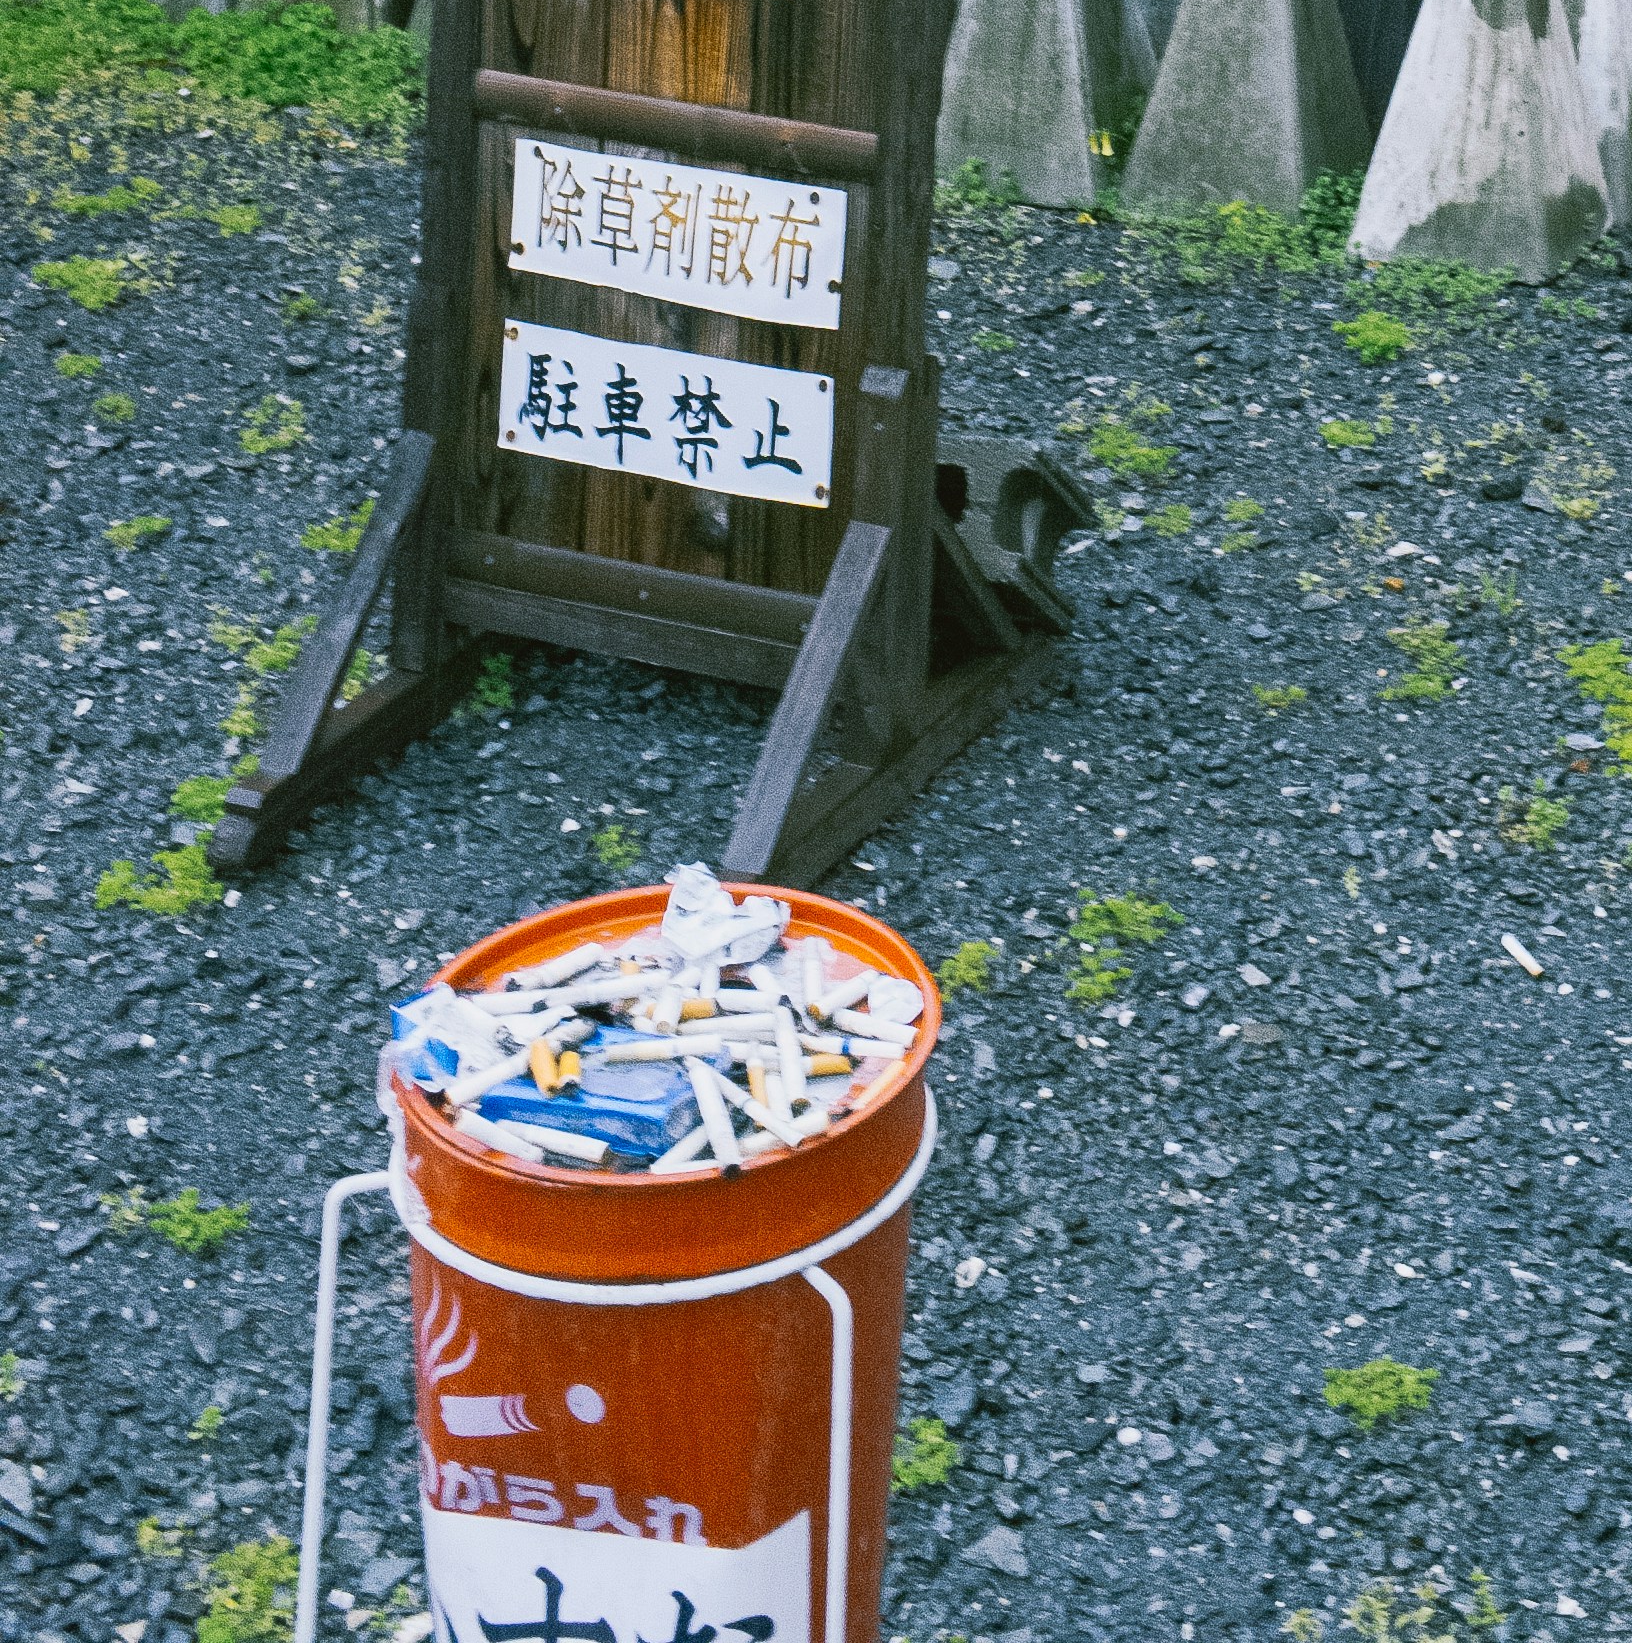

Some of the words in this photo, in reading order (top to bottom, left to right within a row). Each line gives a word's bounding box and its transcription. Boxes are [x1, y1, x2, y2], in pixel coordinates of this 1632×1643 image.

[534, 157, 819, 299] 除草剤散布
[518, 352, 802, 478] 駐車禁止
